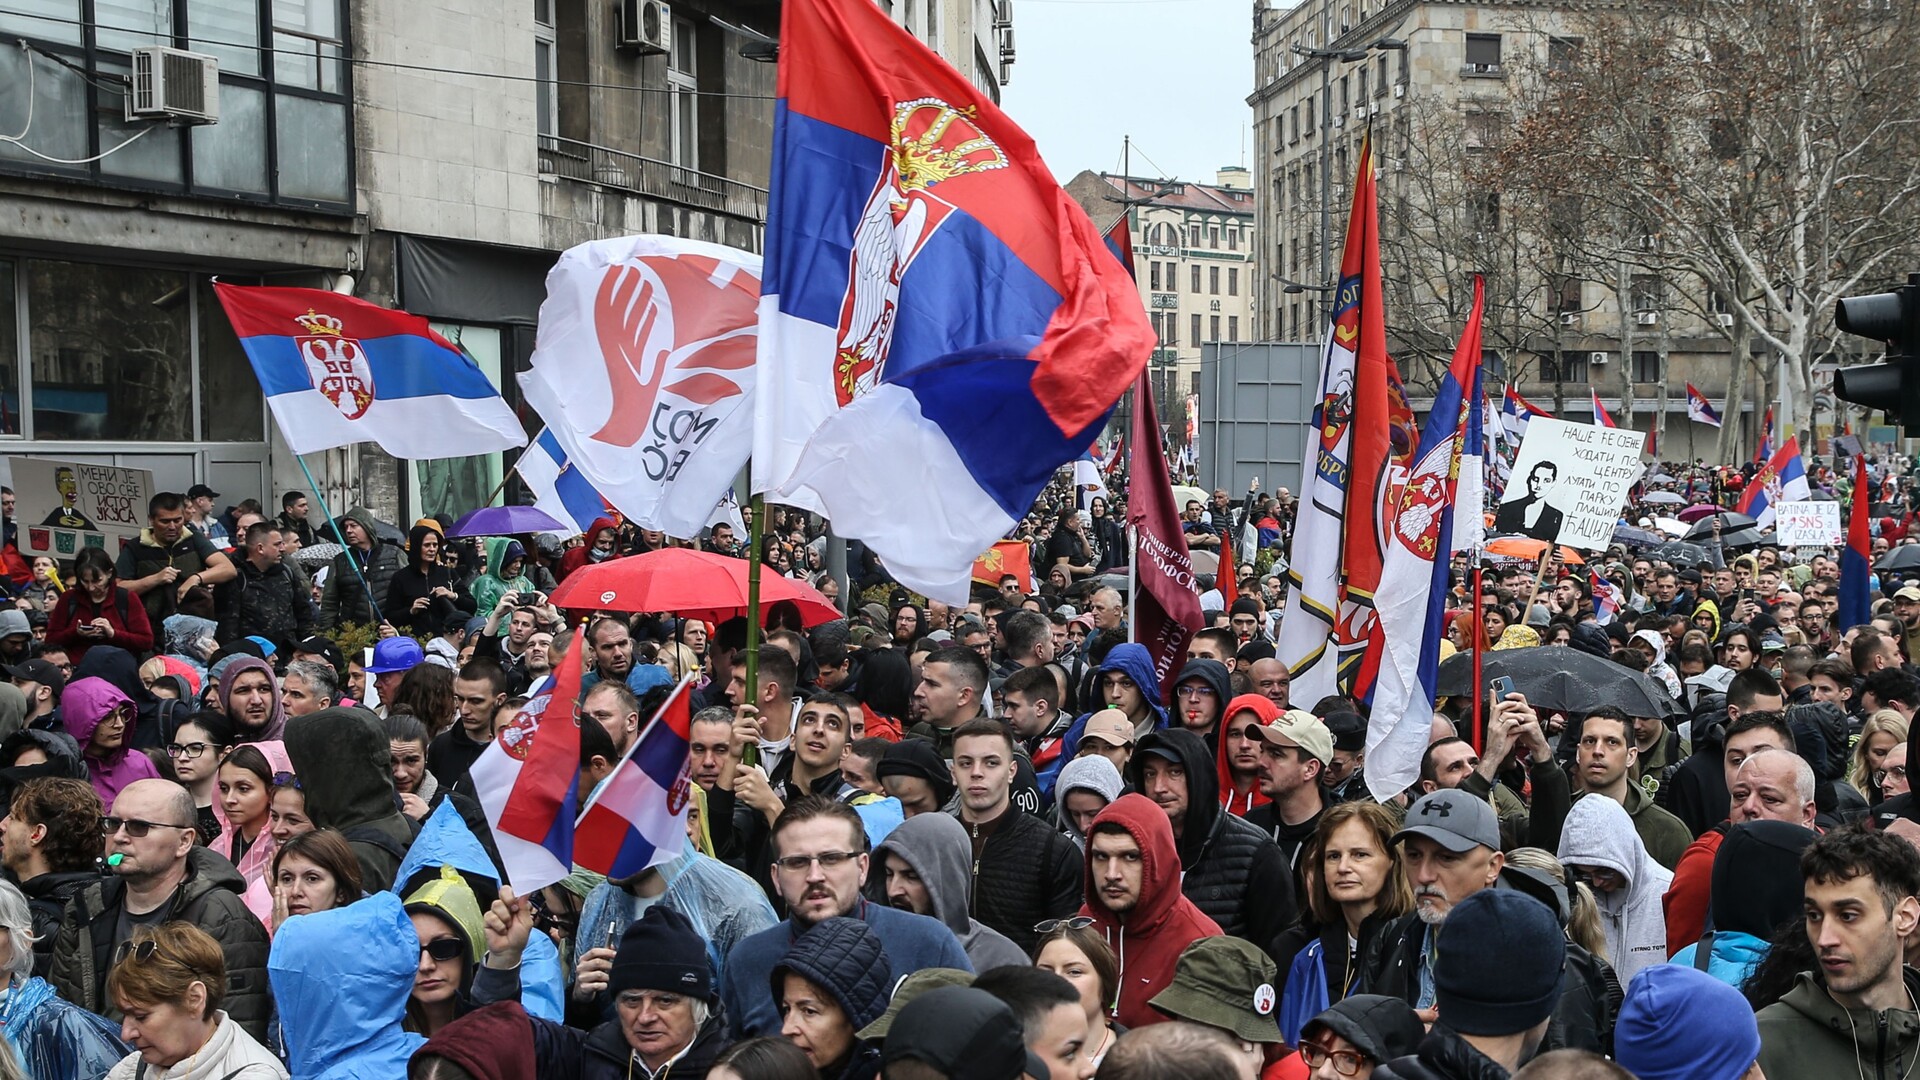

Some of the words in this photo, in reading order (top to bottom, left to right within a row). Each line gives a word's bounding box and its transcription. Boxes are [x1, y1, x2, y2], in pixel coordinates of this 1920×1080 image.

[1562, 426, 1595, 443] НАШЕ
[1601, 431, 1615, 446] ЋЕ
[1572, 447, 1615, 463] ХОДАТИ
[1621, 455, 1638, 466] ПО
[80, 467, 118, 482] МЕНИ
[122, 469, 136, 484] ЈЕ
[1594, 465, 1635, 479] ЦЕНТРУ
[88, 482, 116, 495] ОВО
[119, 484, 141, 498] СВЕ
[1564, 476, 1595, 489] ЛУТАТИ
[1602, 481, 1619, 492] ПО
[97, 495, 136, 510] ИСТОГ
[1580, 490, 1616, 505] ПАРКУ
[96, 507, 138, 525] УКУСА
[1575, 502, 1620, 518] ПЛАШИТИ
[1564, 511, 1615, 541] ЋАЦИЈА
